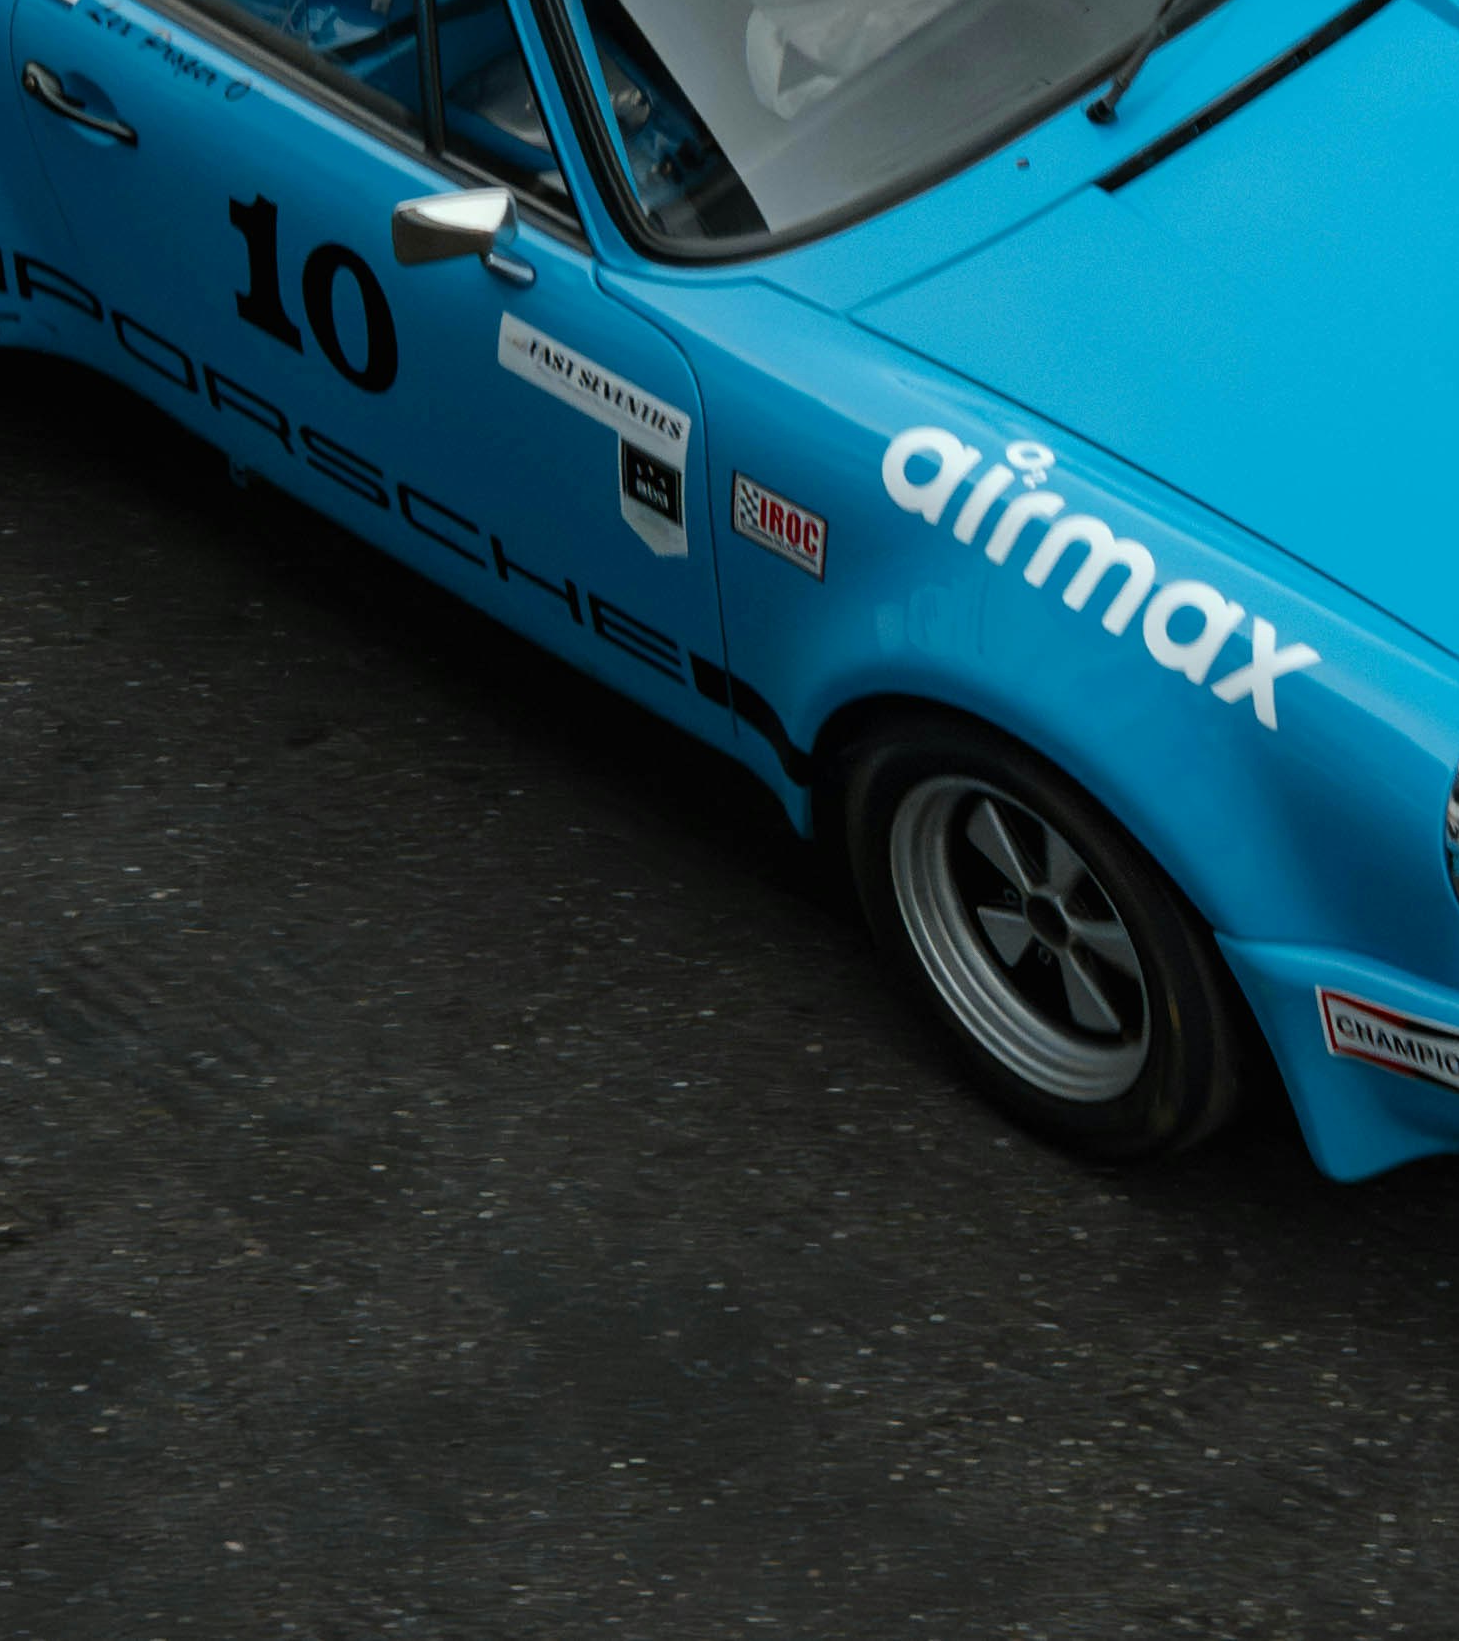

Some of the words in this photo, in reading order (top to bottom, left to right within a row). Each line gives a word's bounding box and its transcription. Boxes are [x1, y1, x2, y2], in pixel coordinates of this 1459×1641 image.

[229, 193, 399, 394] 10
[528, 339, 574, 380] FAST
[577, 368, 683, 441] SEVENTIES
[14, 252, 687, 686] PORSCHE
[758, 496, 819, 558] IROC
[881, 425, 1323, 732] airmax
